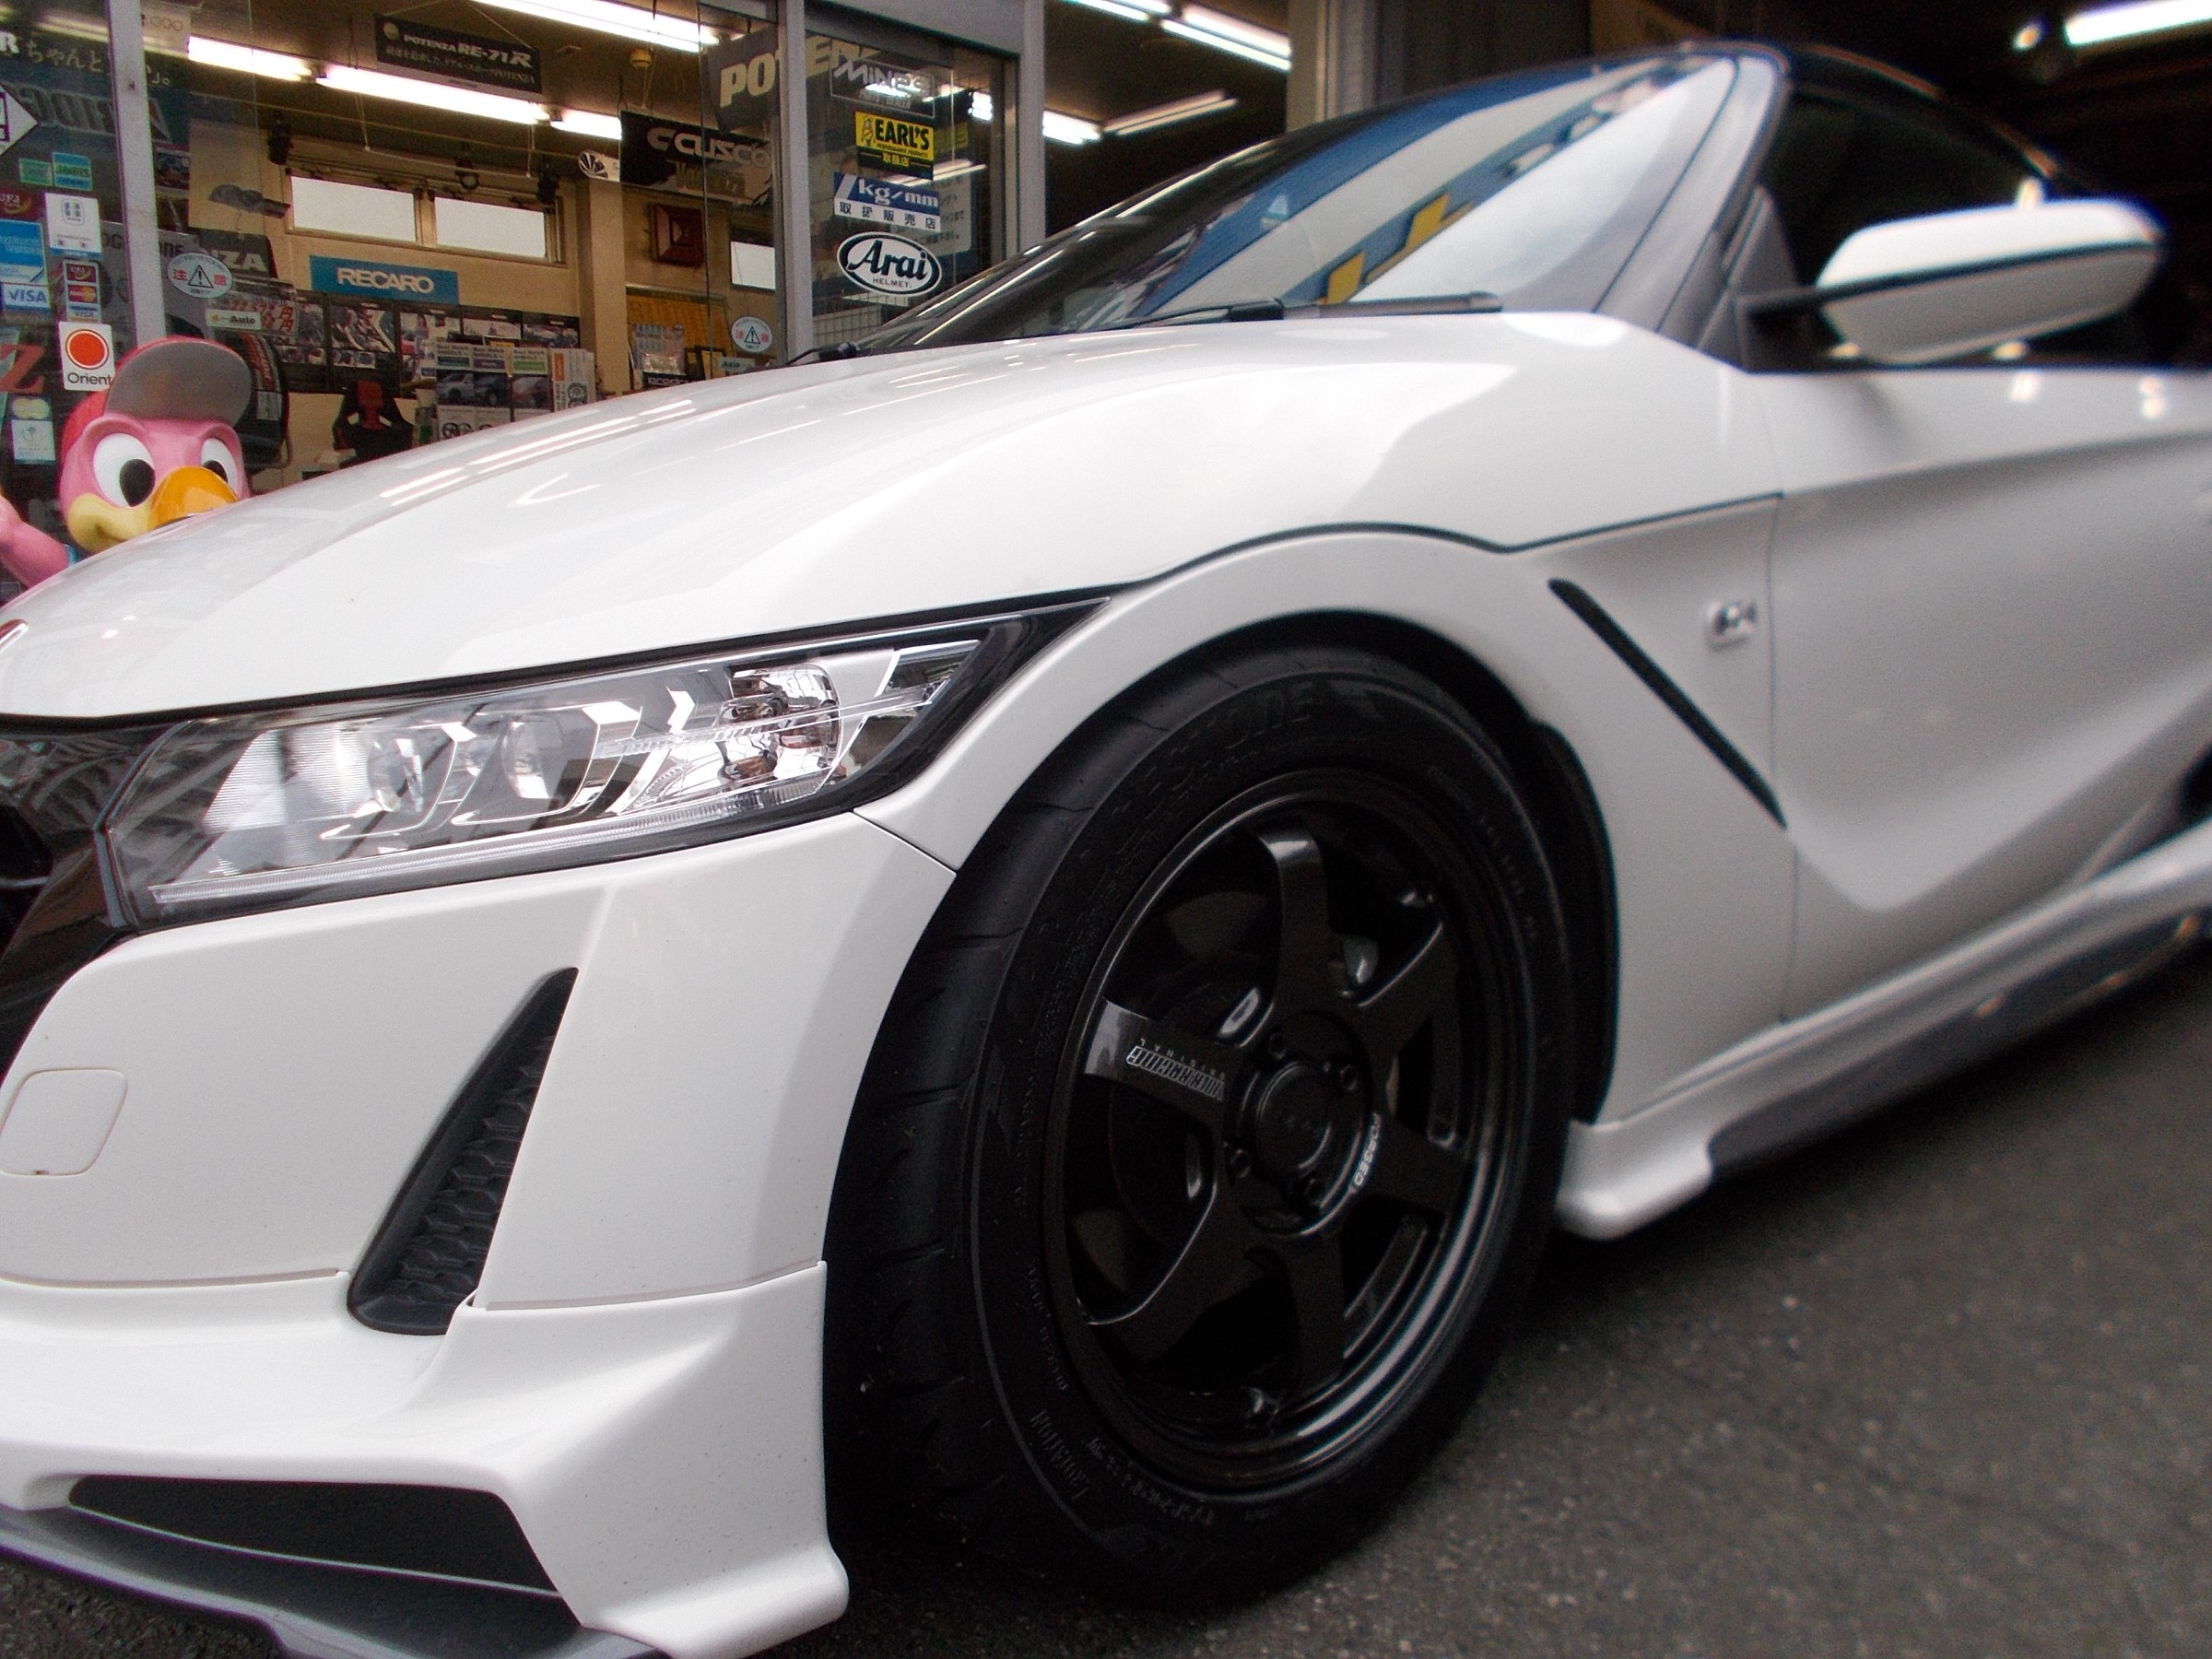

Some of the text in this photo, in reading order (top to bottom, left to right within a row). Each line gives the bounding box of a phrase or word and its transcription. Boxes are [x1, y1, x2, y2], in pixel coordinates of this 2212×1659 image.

[875, 118, 929, 151] EARL'S
[840, 202, 936, 229] 取扱販売店
[846, 240, 928, 280] Arai
[336, 266, 434, 295] RECARO
[873, 278, 909, 288] HELMET
[9, 288, 46, 303] VISA
[67, 371, 112, 386] Orient
